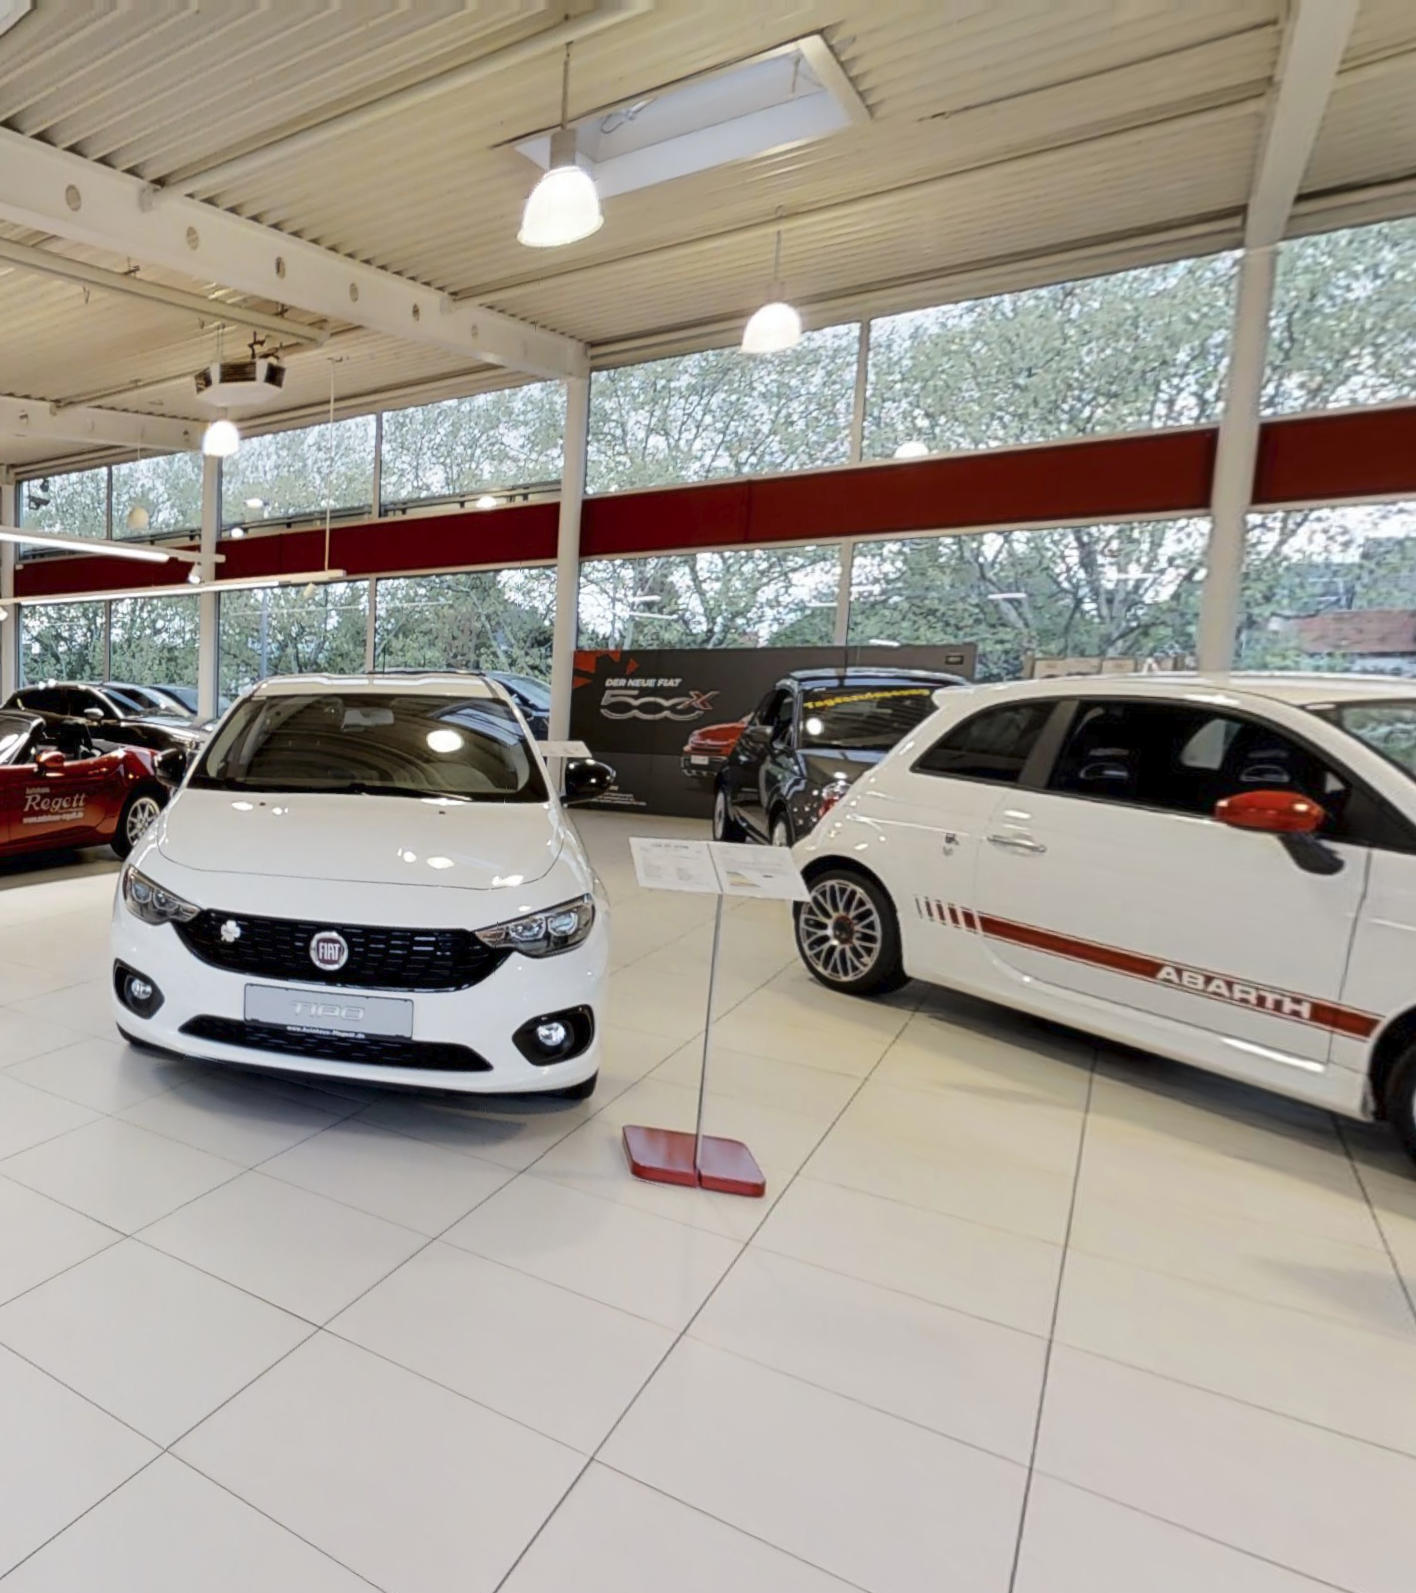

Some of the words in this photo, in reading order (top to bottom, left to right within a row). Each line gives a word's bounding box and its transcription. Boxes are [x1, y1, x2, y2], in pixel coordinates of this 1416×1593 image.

[605, 678, 626, 687] DER
[627, 678, 657, 687] NEUE
[657, 678, 682, 687] FIAT
[23, 792, 88, 813] Regett
[318, 942, 341, 960] FIAT
[1155, 965, 1312, 1020] ABARTH
[291, 1001, 366, 1021] TIPO
